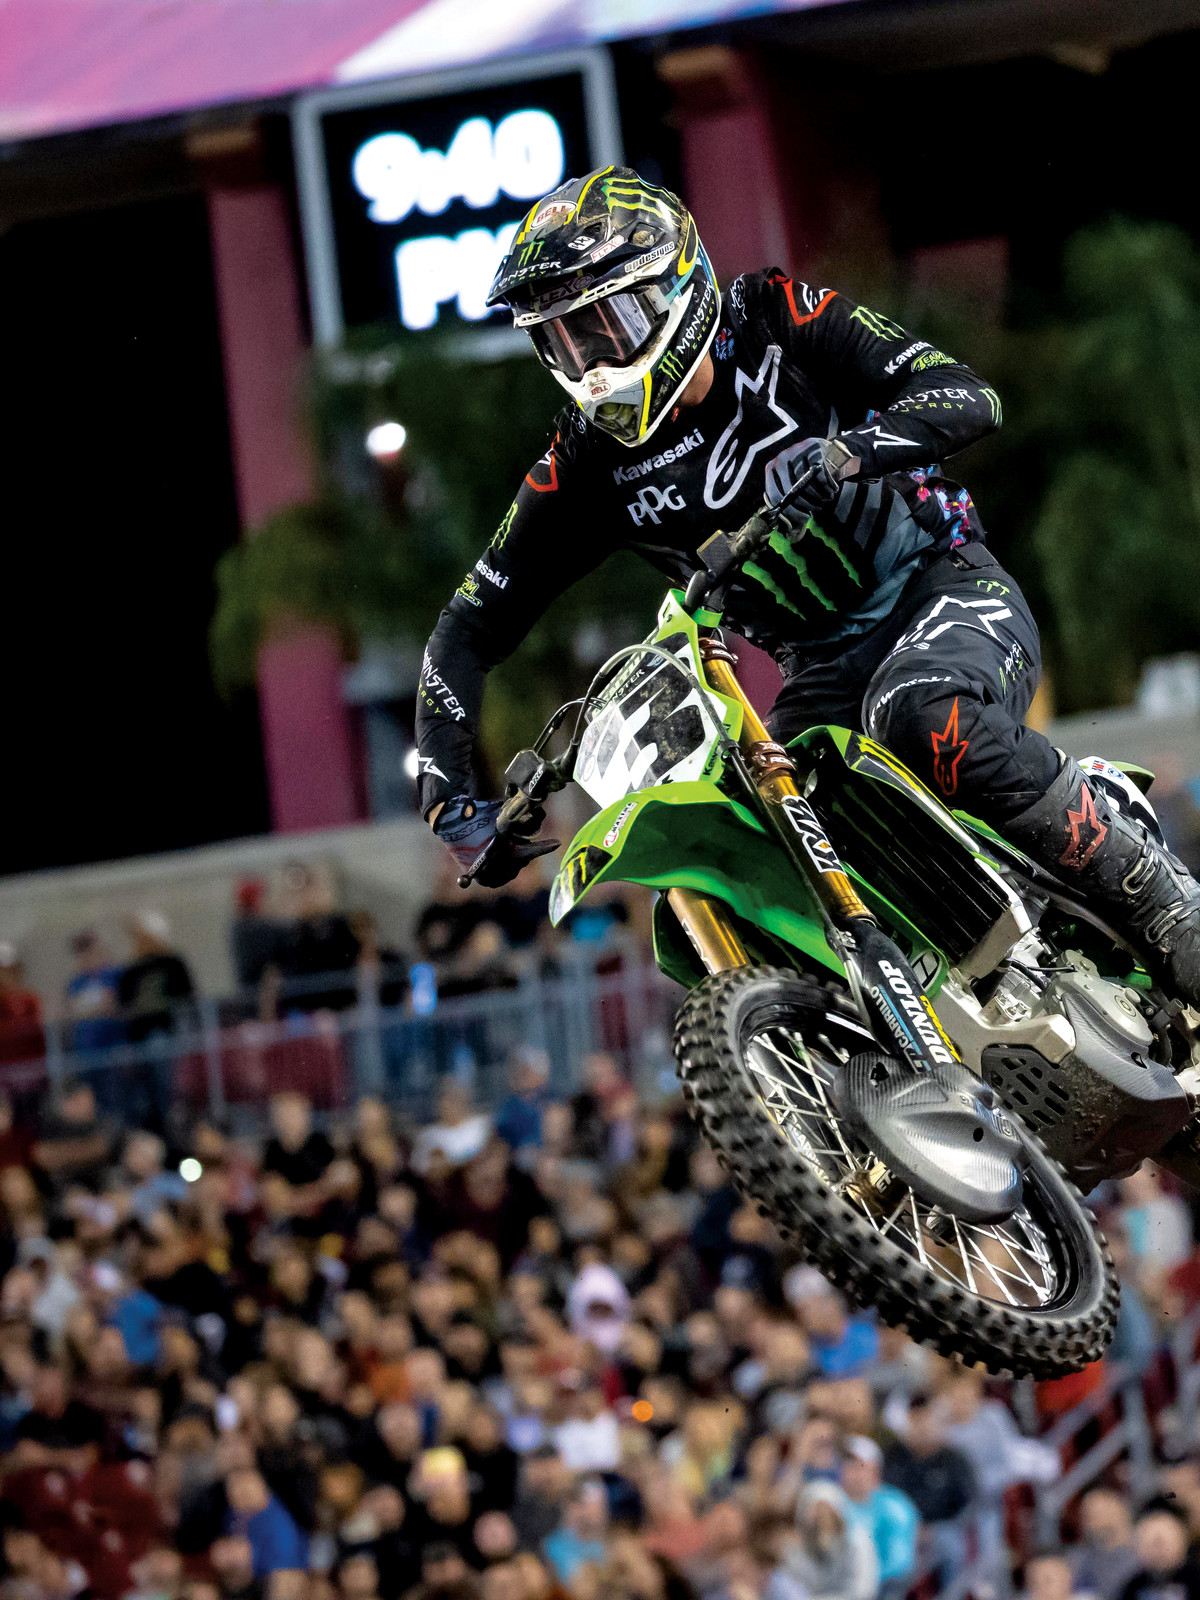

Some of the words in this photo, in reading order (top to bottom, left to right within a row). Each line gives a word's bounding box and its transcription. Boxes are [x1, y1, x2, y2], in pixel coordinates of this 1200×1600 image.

[353, 109, 564, 223] 9:40
[536, 204, 567, 224] BELL
[625, 243, 675, 272] apdesigns
[590, 383, 609, 396] BELL
[888, 388, 976, 412] ONSTER
[613, 428, 705, 485] Kawasaki
[871, 985, 909, 1048] CARRILLO
[878, 960, 953, 1063] DUNLOP
